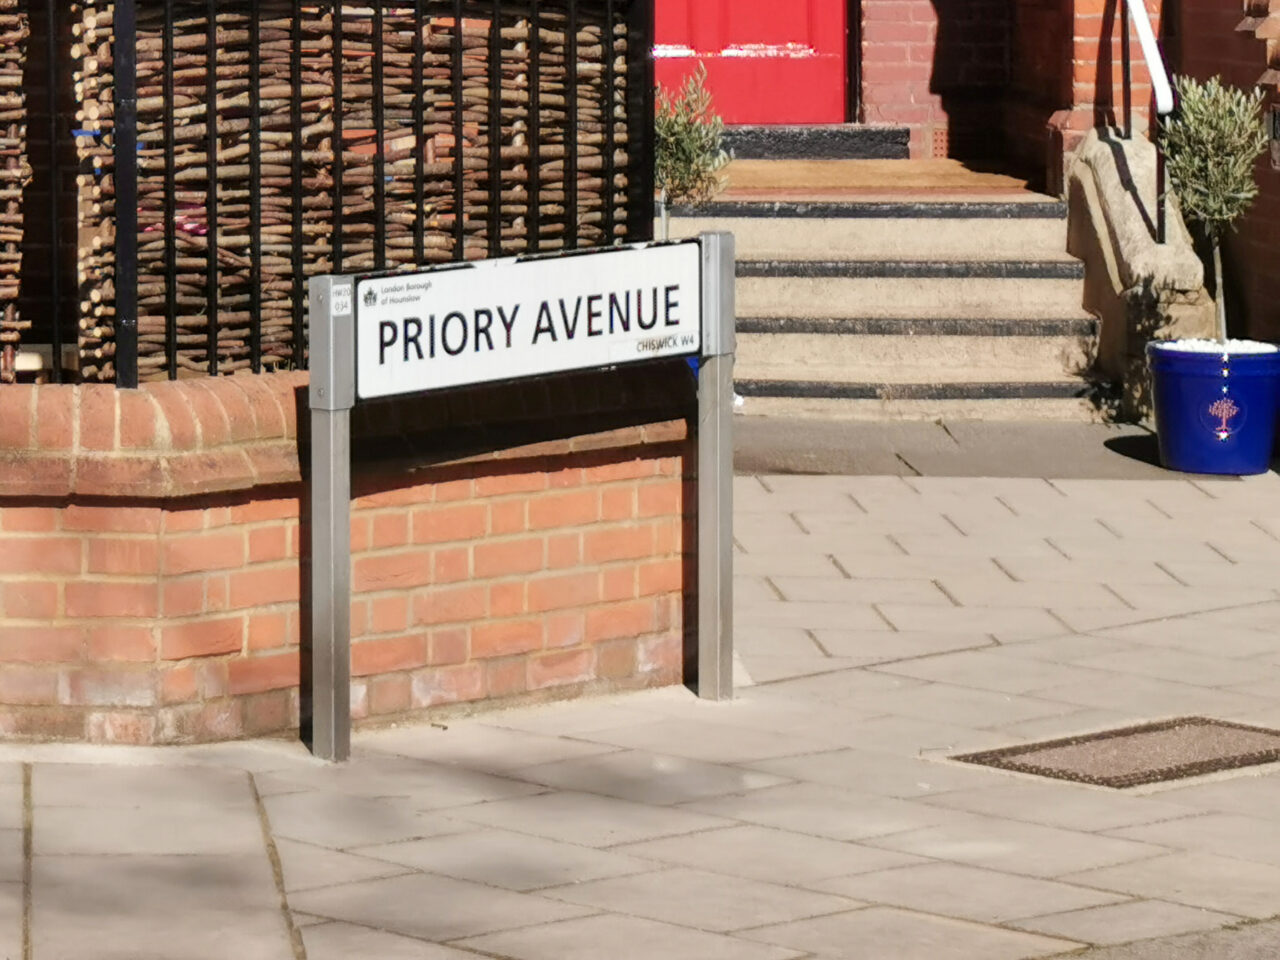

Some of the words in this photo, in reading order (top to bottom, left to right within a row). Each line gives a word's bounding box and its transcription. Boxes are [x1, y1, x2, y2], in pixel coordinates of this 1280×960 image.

[380, 283, 405, 294] London
[406, 279, 432, 292] Borough
[380, 296, 388, 306] of
[389, 294, 421, 305] Hounslow
[379, 304, 520, 365] PRIORY
[532, 284, 680, 345] AVENUE
[636, 336, 678, 353] CHISWICK
[680, 334, 695, 346] W4
